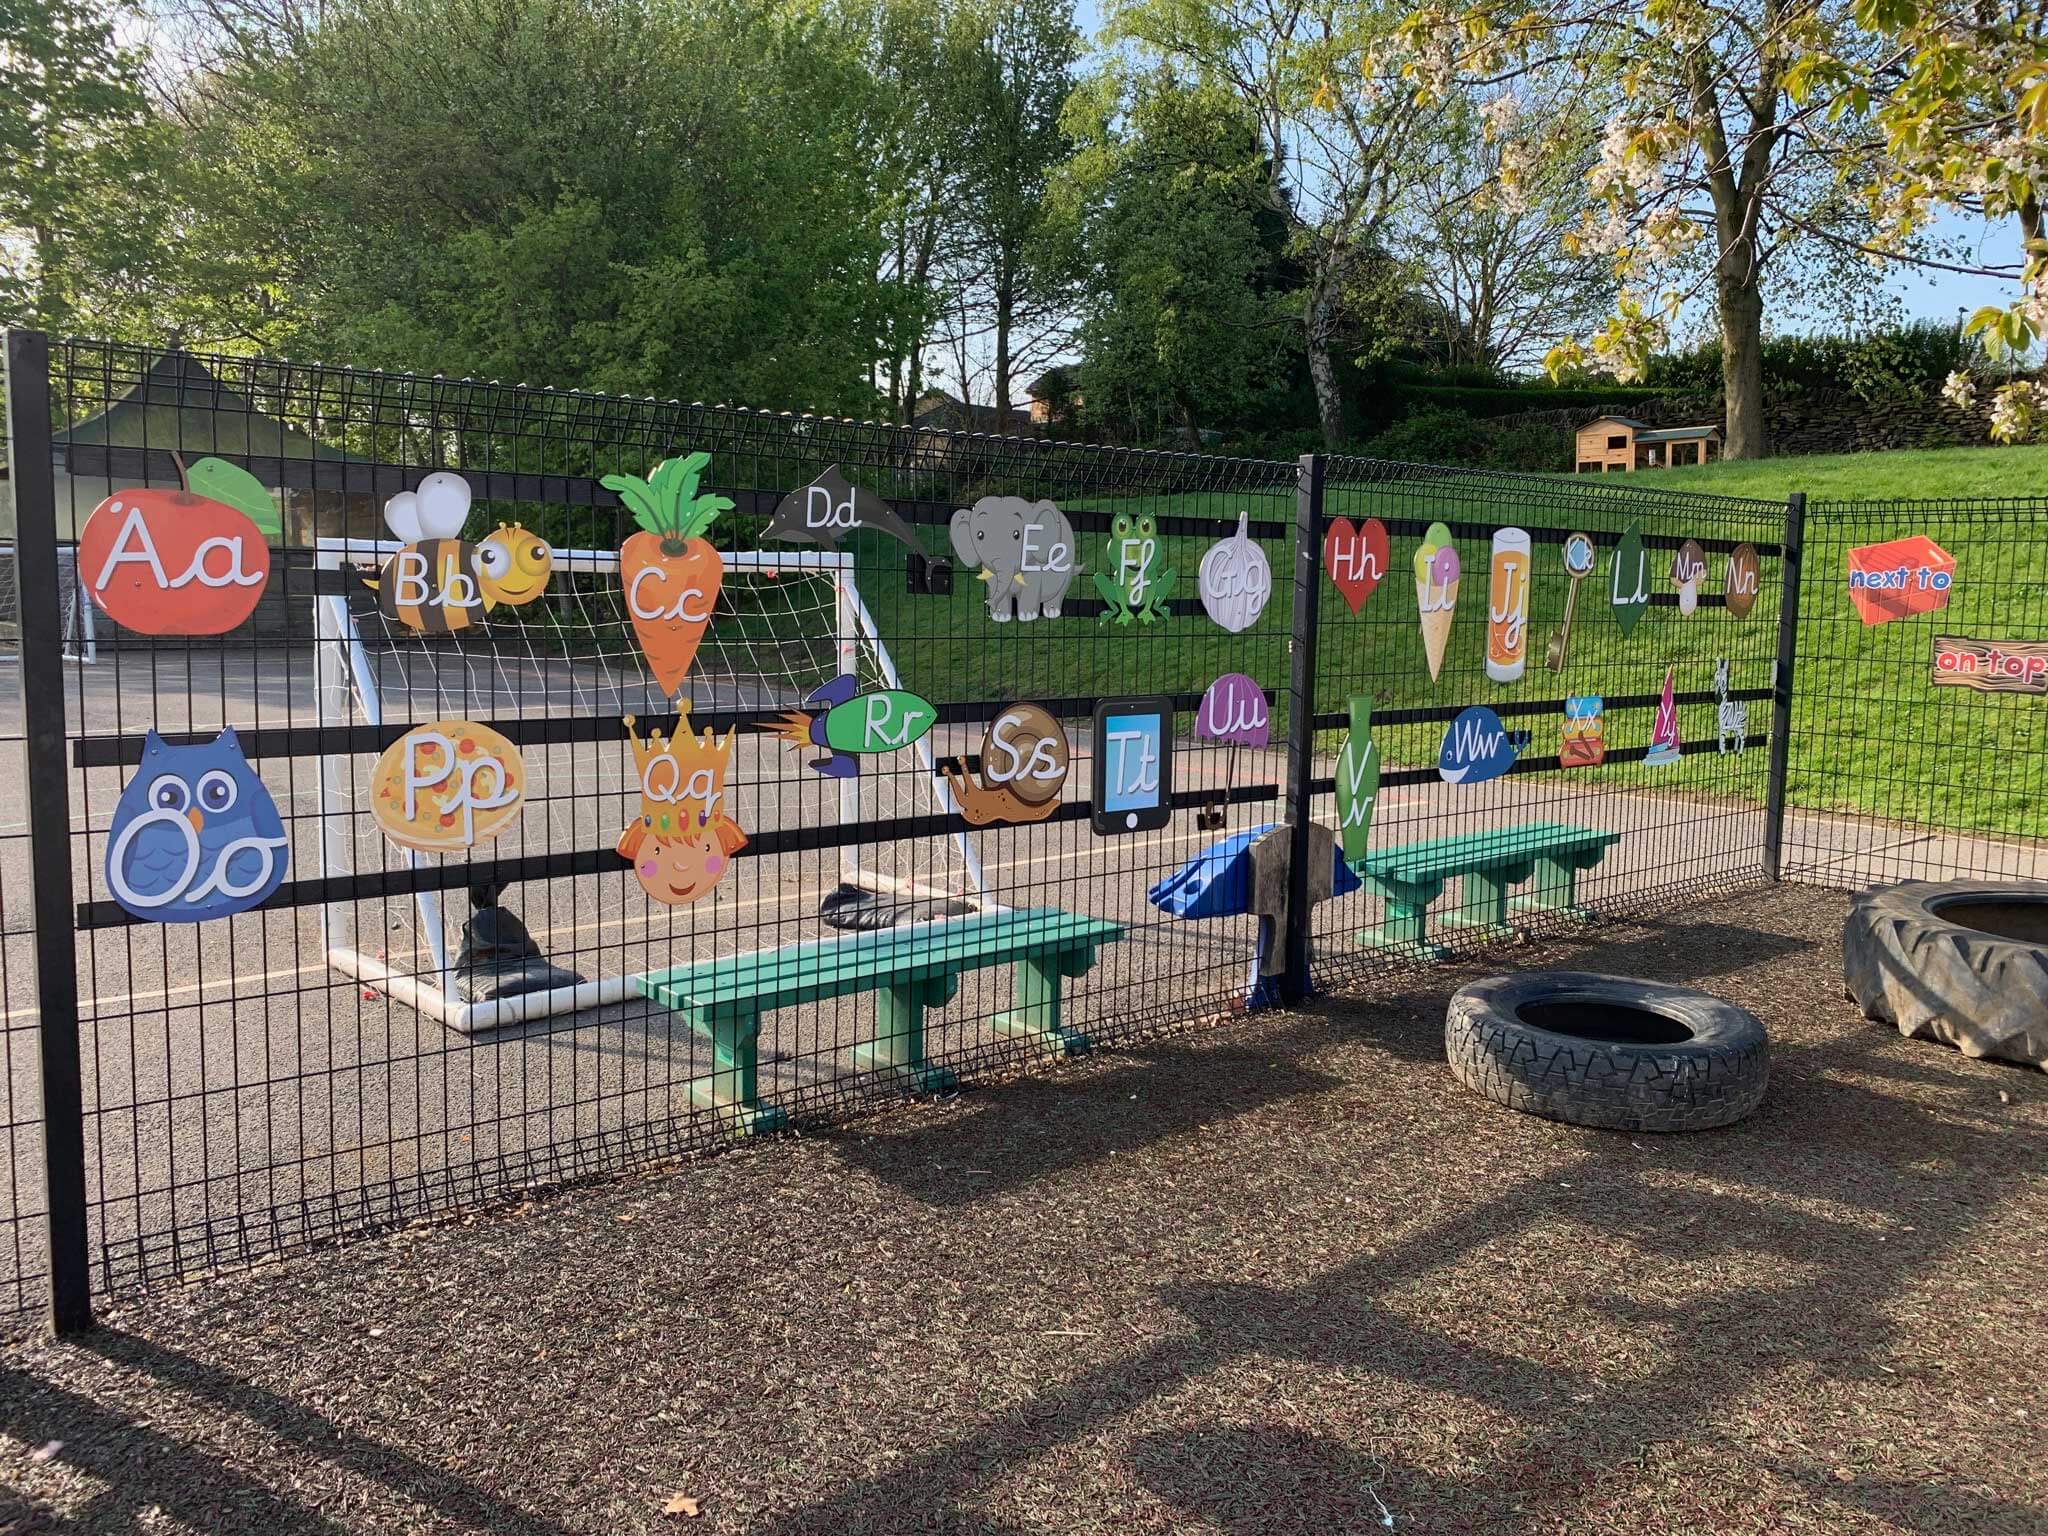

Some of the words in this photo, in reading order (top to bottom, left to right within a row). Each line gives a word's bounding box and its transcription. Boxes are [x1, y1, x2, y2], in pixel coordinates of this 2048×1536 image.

[806, 486, 862, 529] Dd
[96, 507, 264, 590] Aa
[1020, 524, 1071, 573] Ee
[1120, 538, 1155, 605] Ff
[1333, 536, 1383, 581] Hh
[1566, 537, 1594, 571] Kk
[1675, 552, 1707, 581] Mm
[395, 552, 483, 607] Bb
[629, 566, 708, 623] Cc
[1207, 549, 1267, 614] Gg
[1421, 555, 1455, 612] Ii
[1612, 550, 1649, 605] Ll
[1726, 557, 1758, 595] Nn
[1850, 567, 1909, 589] next
[1918, 567, 1951, 589] to
[1491, 563, 1525, 649] Jj
[1938, 652, 1977, 673] on
[1988, 650, 2046, 684] top
[862, 694, 924, 748] Rr
[1207, 683, 1267, 736] Uu
[1569, 699, 1598, 731] Xx
[1660, 702, 1675, 746] Yy
[986, 715, 1066, 783] Ss
[1107, 731, 1159, 796] Tt
[1455, 718, 1504, 764] Ww
[404, 733, 519, 846] Pp
[642, 754, 722, 818] Qq
[108, 806, 288, 908] Oo
